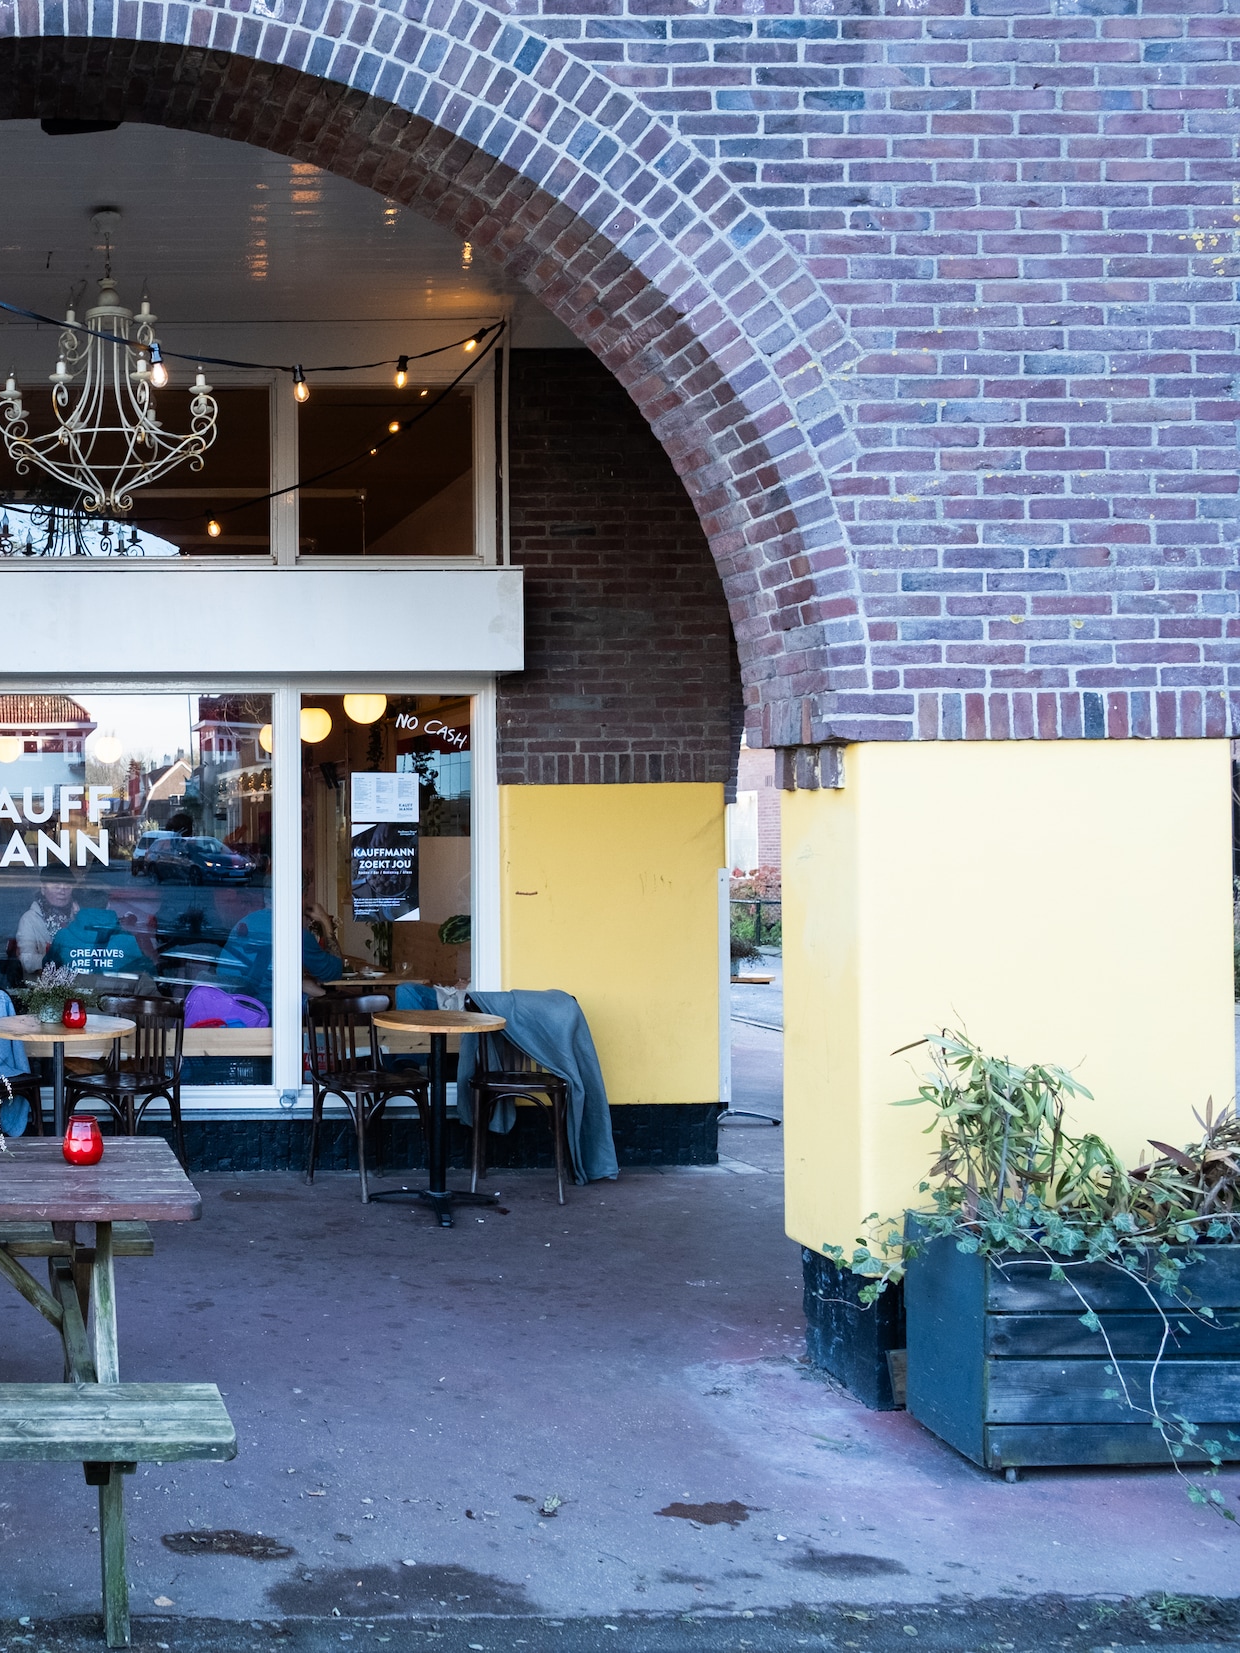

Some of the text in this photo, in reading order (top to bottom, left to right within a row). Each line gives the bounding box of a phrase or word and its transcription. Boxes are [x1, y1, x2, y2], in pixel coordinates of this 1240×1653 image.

[395, 713, 468, 749] NO CASH
[353, 848, 415, 857] KAUFFMANN
[359, 860, 411, 869] ZOEKT JOU
[70, 949, 124, 958] CREATIVES
[71, 959, 113, 968] ARE THE
